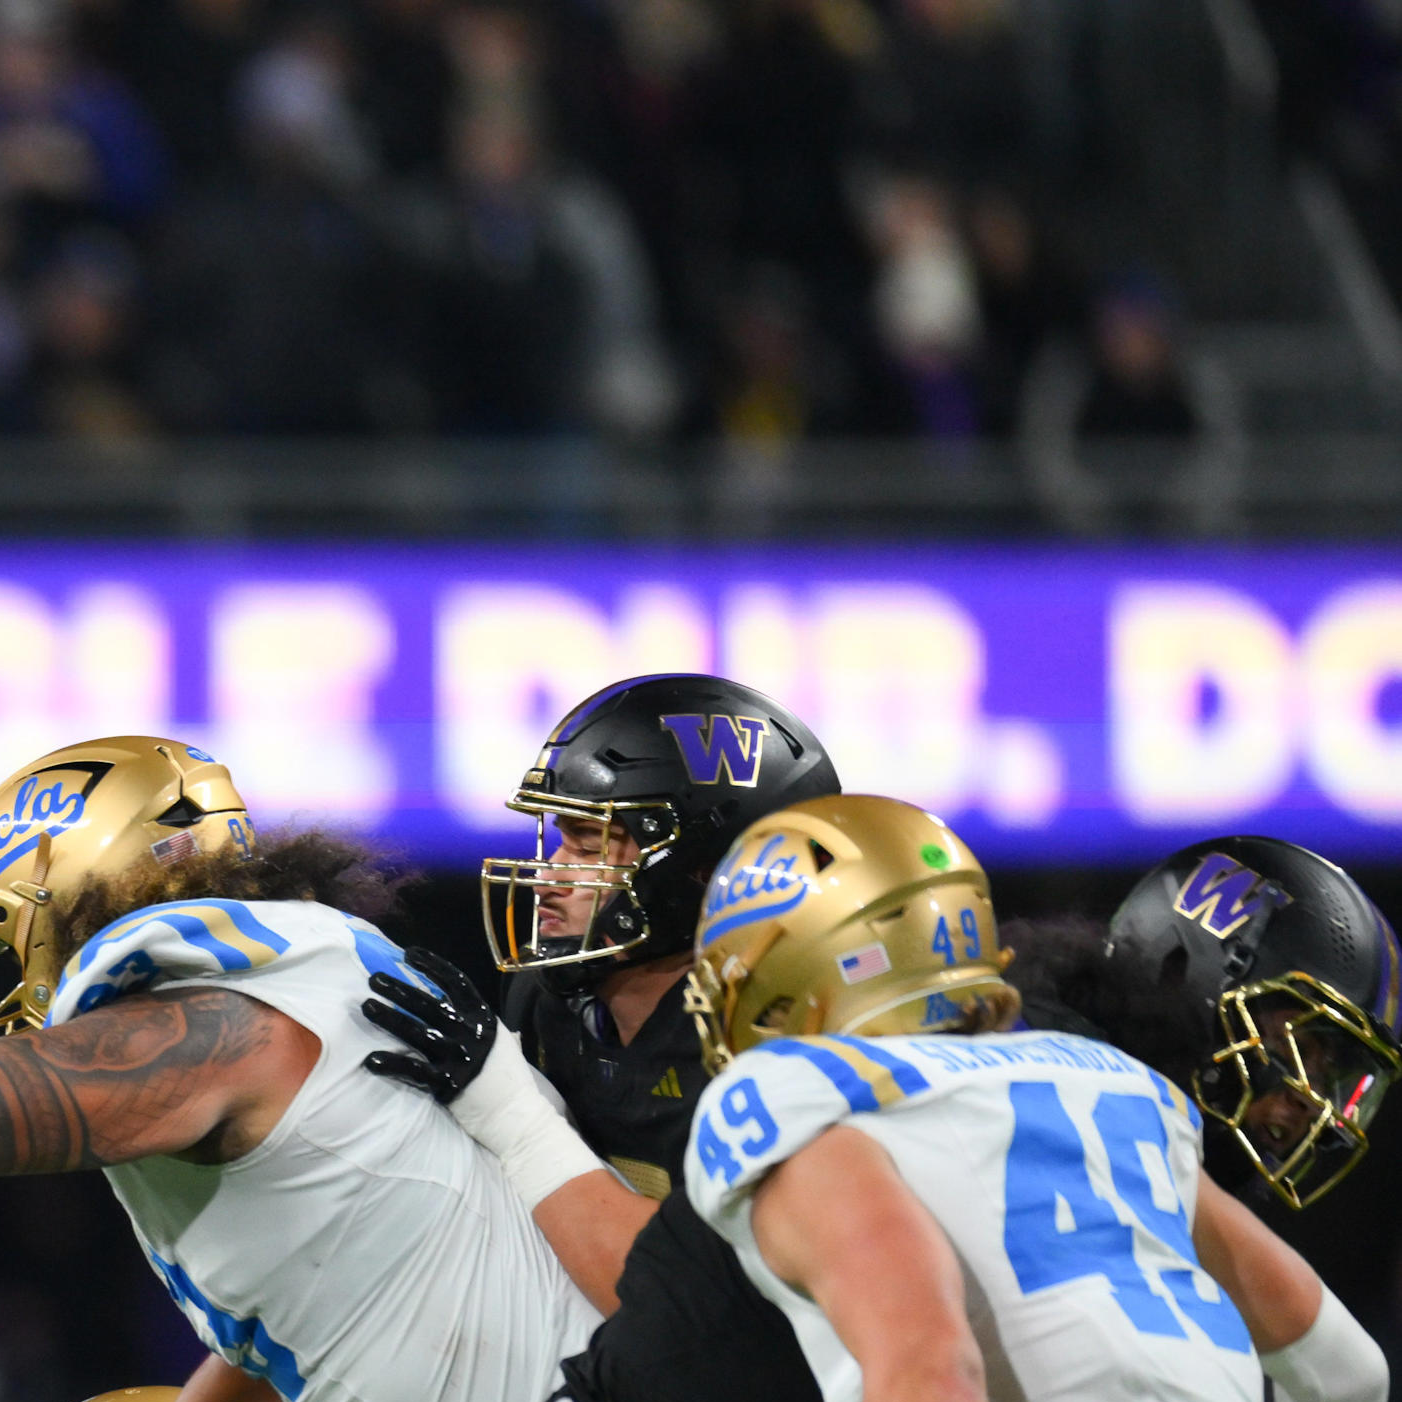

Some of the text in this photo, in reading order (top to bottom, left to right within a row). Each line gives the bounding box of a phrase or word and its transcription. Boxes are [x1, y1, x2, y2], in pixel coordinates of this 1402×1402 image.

[660, 714, 770, 788] W
[931, 908, 981, 965] 49
[1172, 852, 1294, 940] W
[697, 1077, 781, 1188] 49
[1004, 1080, 1252, 1356] 49
